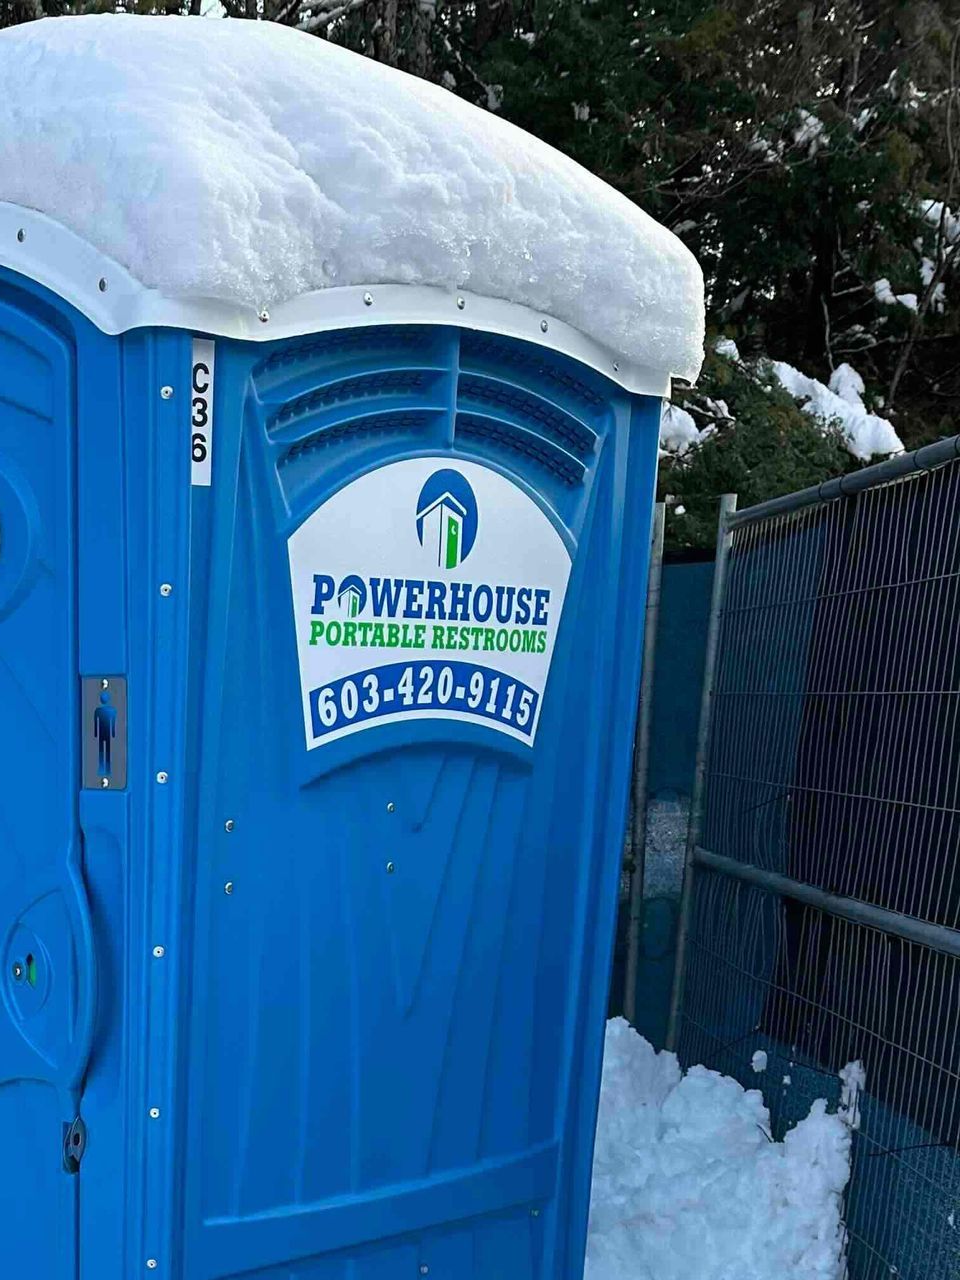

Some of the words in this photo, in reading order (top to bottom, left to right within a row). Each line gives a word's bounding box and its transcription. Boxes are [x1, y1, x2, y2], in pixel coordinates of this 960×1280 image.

[192, 362, 210, 463] C36
[310, 574, 551, 626] POWERHOUSE
[309, 620, 425, 649] PORTABLE
[431, 626, 548, 654] RESTROOMS
[317, 666, 534, 727] 603-420-9115
